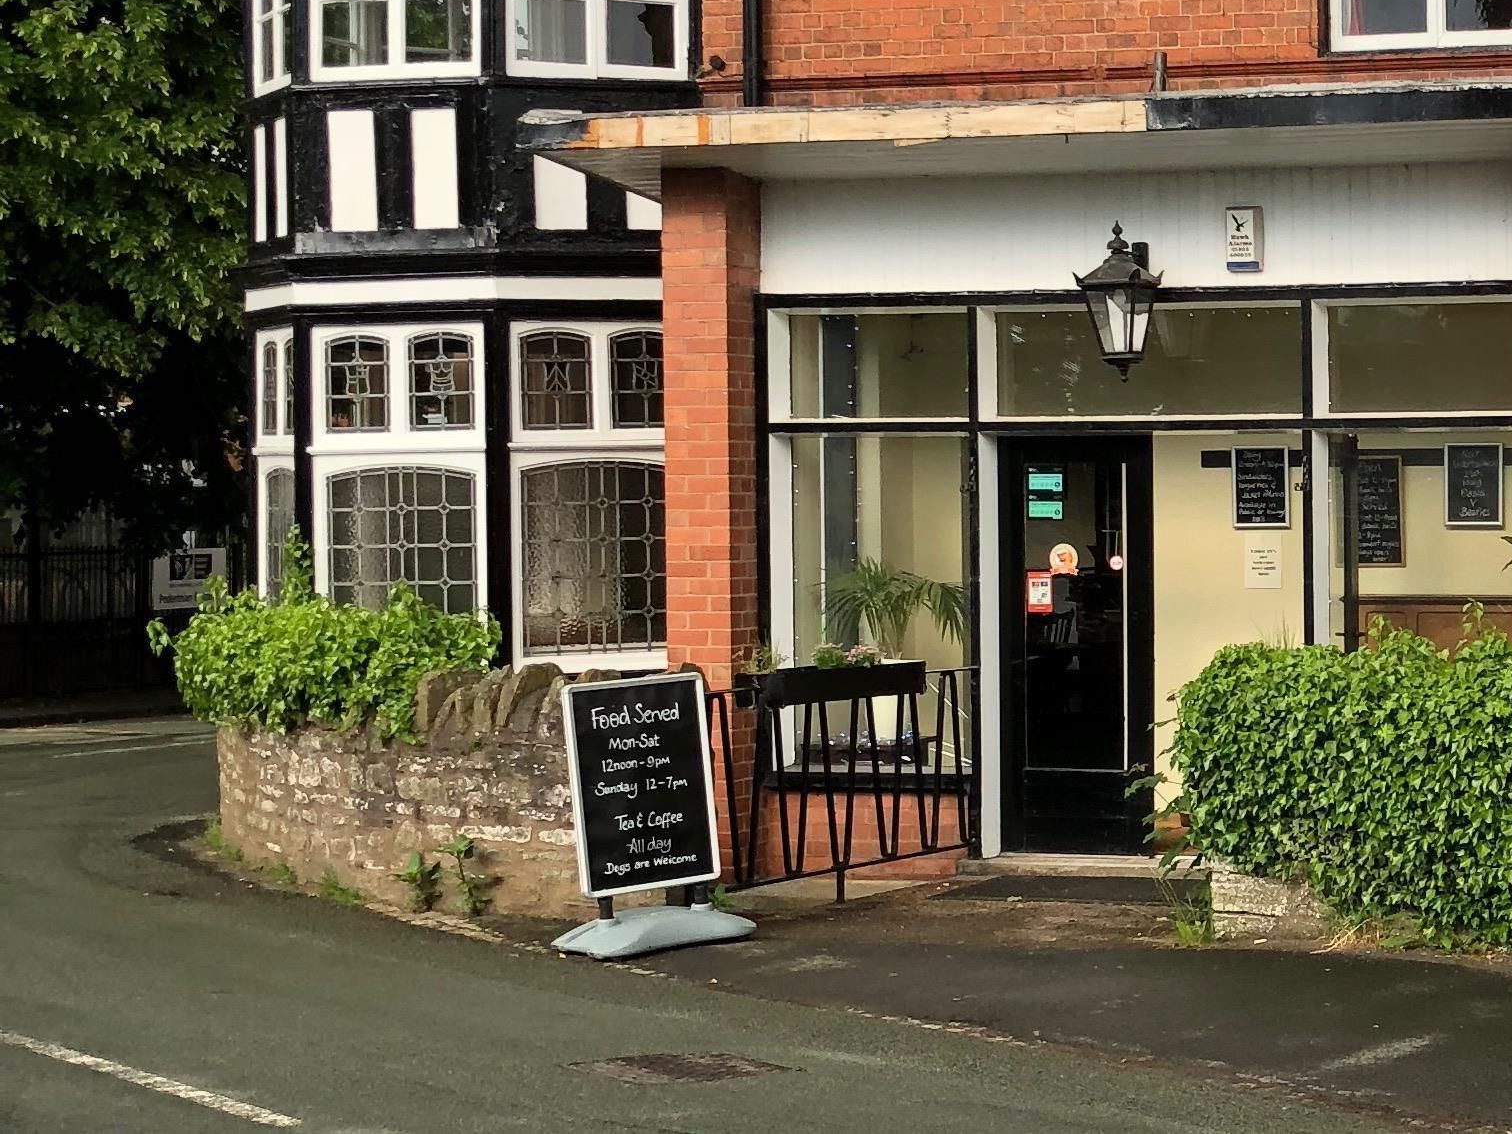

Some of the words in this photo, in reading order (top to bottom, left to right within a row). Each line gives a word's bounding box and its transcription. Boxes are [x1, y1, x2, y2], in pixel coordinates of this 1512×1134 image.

[591, 705, 631, 729] Food
[633, 702, 680, 724] Served
[608, 733, 660, 751] Mon-Sat
[595, 782, 638, 799] Sunday
[614, 814, 635, 831] Tea
[647, 810, 684, 829] Coffee
[626, 837, 645, 854] All
[647, 836, 672, 854] day
[604, 862, 631, 876] Dogs
[634, 860, 651, 870] are
[653, 854, 698, 867] Welcome
